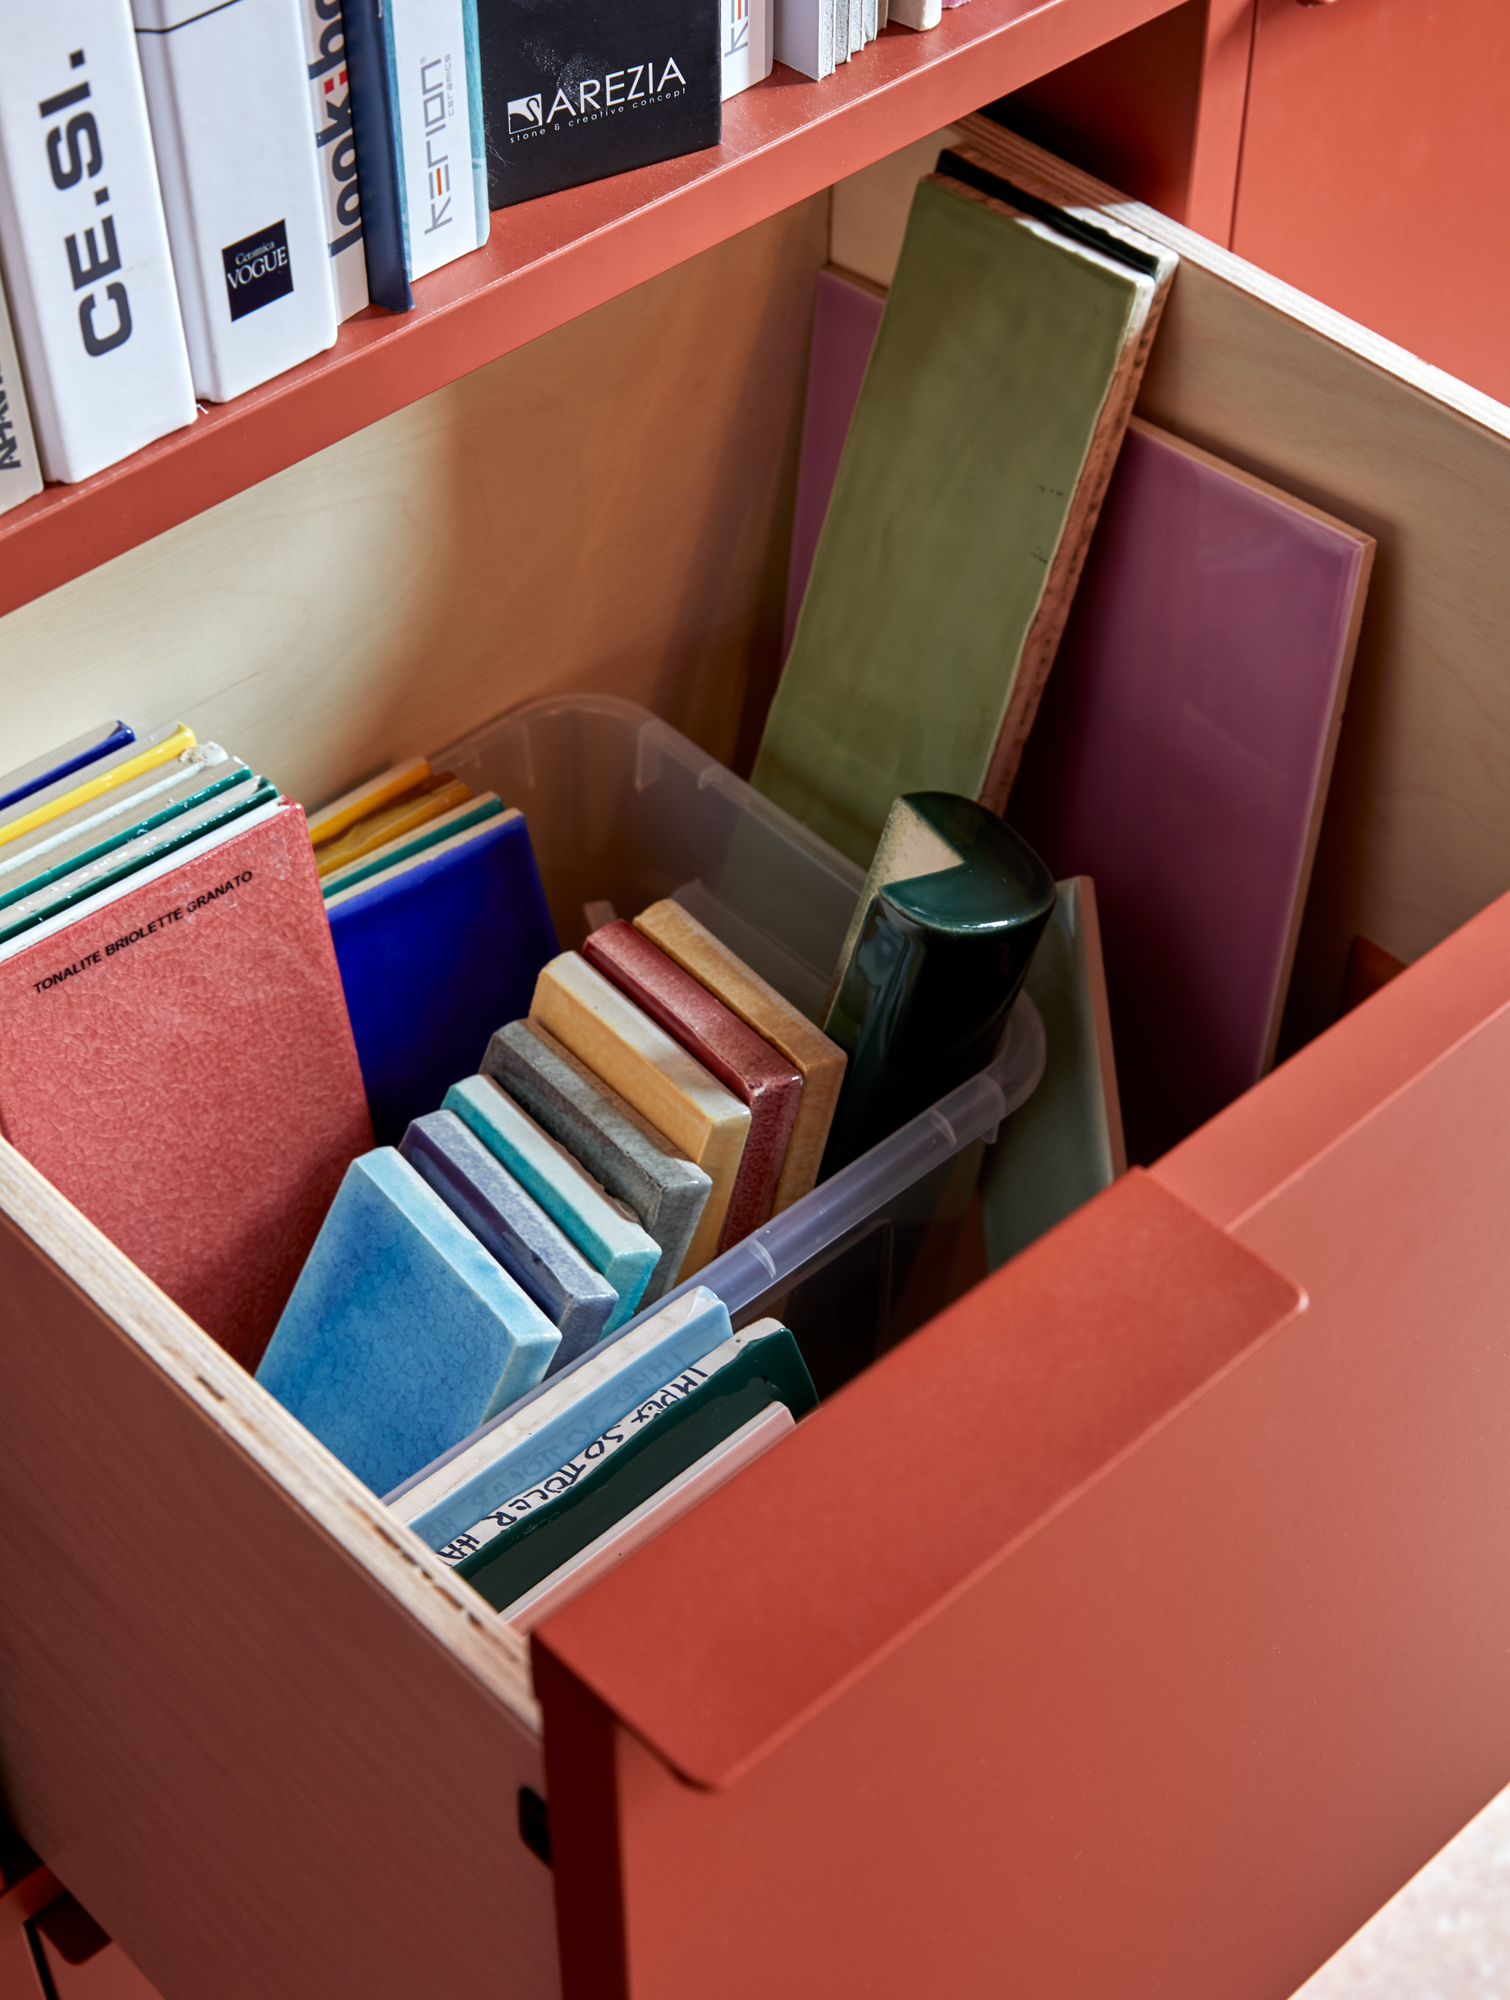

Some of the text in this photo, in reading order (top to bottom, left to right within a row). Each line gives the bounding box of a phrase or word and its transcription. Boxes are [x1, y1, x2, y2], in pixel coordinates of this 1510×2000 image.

[509, 86, 687, 144] stone & creative concept
[546, 56, 687, 124] AREZIA
[38, 48, 134, 358] CE.SI.
[227, 245, 288, 289] VOGUE
[235, 241, 275, 265] Ceramica
[32, 870, 253, 994] TONALITE BRIOLETTE GRANATO
[438, 1533, 480, 1567] HA
